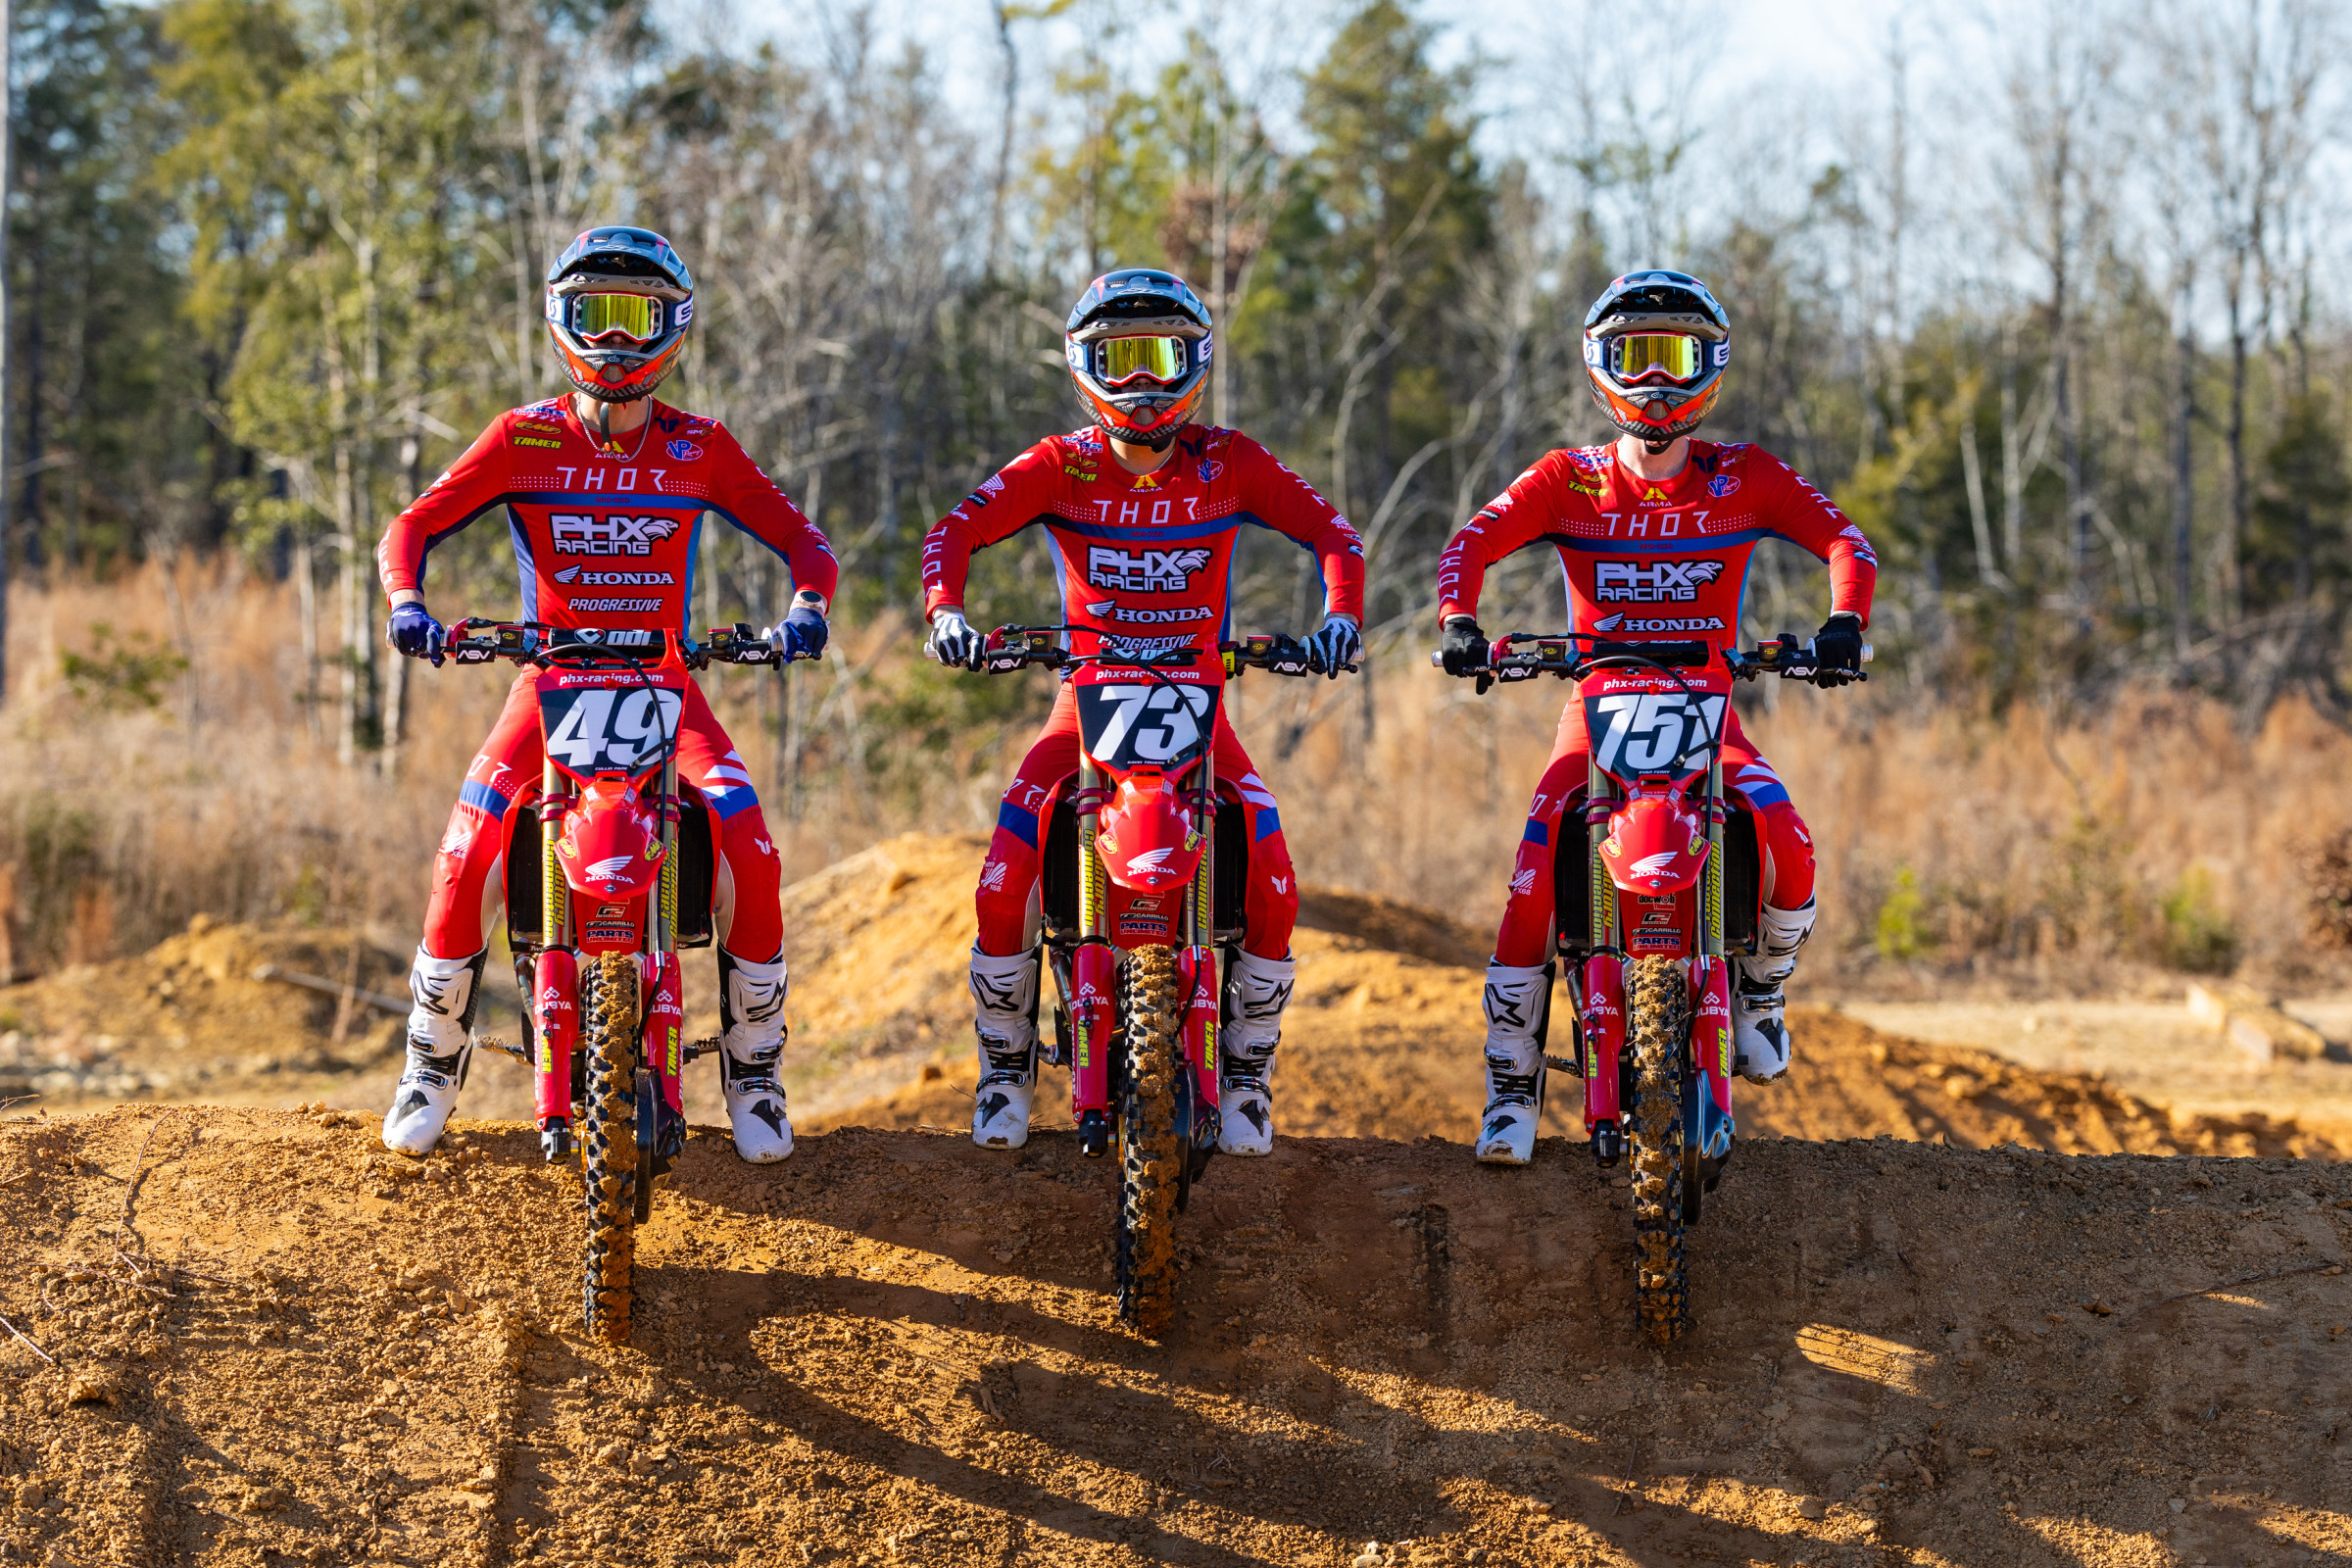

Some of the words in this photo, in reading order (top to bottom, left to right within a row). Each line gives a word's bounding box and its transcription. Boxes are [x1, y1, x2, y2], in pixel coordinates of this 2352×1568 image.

[514, 437, 562, 449] TAMER
[666, 440, 692, 460] VP
[557, 466, 667, 491] THOR
[1708, 475, 1730, 497] VP
[1093, 497, 1200, 524] THOR
[551, 515, 652, 541] PHX
[1601, 511, 1709, 536] THOR
[555, 540, 651, 555] RACING
[1089, 546, 1186, 576] PHX
[581, 572, 675, 584] HONDA
[1090, 571, 1187, 591] RACING
[1596, 562, 1694, 587] PHX
[1597, 587, 1695, 601] RACING
[568, 598, 664, 612] PROGRESSIVE
[1114, 606, 1214, 622] HONDA
[1624, 617, 1726, 631] HONDA
[458, 650, 490, 660] ASV
[738, 651, 770, 661] ASV
[990, 658, 1021, 670] ASV
[1274, 662, 1306, 672] ASV
[1785, 666, 1817, 676] ASV
[1500, 666, 1533, 677] ASV
[1835, 667, 1859, 678] ASV
[547, 688, 682, 767] 49
[1092, 684, 1209, 761] 73
[1595, 694, 1726, 773] 751
[1084, 829, 1095, 927] Connection
[1127, 866, 1177, 877] HONDA
[1630, 870, 1680, 880] HONDA
[585, 874, 635, 884] HONDA
[1518, 887, 1532, 896] X68
[1710, 842, 1721, 940] Connection
[1120, 922, 1167, 932] PARTS
[587, 930, 634, 939] PARTS
[1633, 937, 1680, 946] PARTS
[666, 1025, 678, 1077] TAMER
[1204, 1019, 1214, 1071] TAMER
[1717, 1027, 1728, 1079] TAMER
